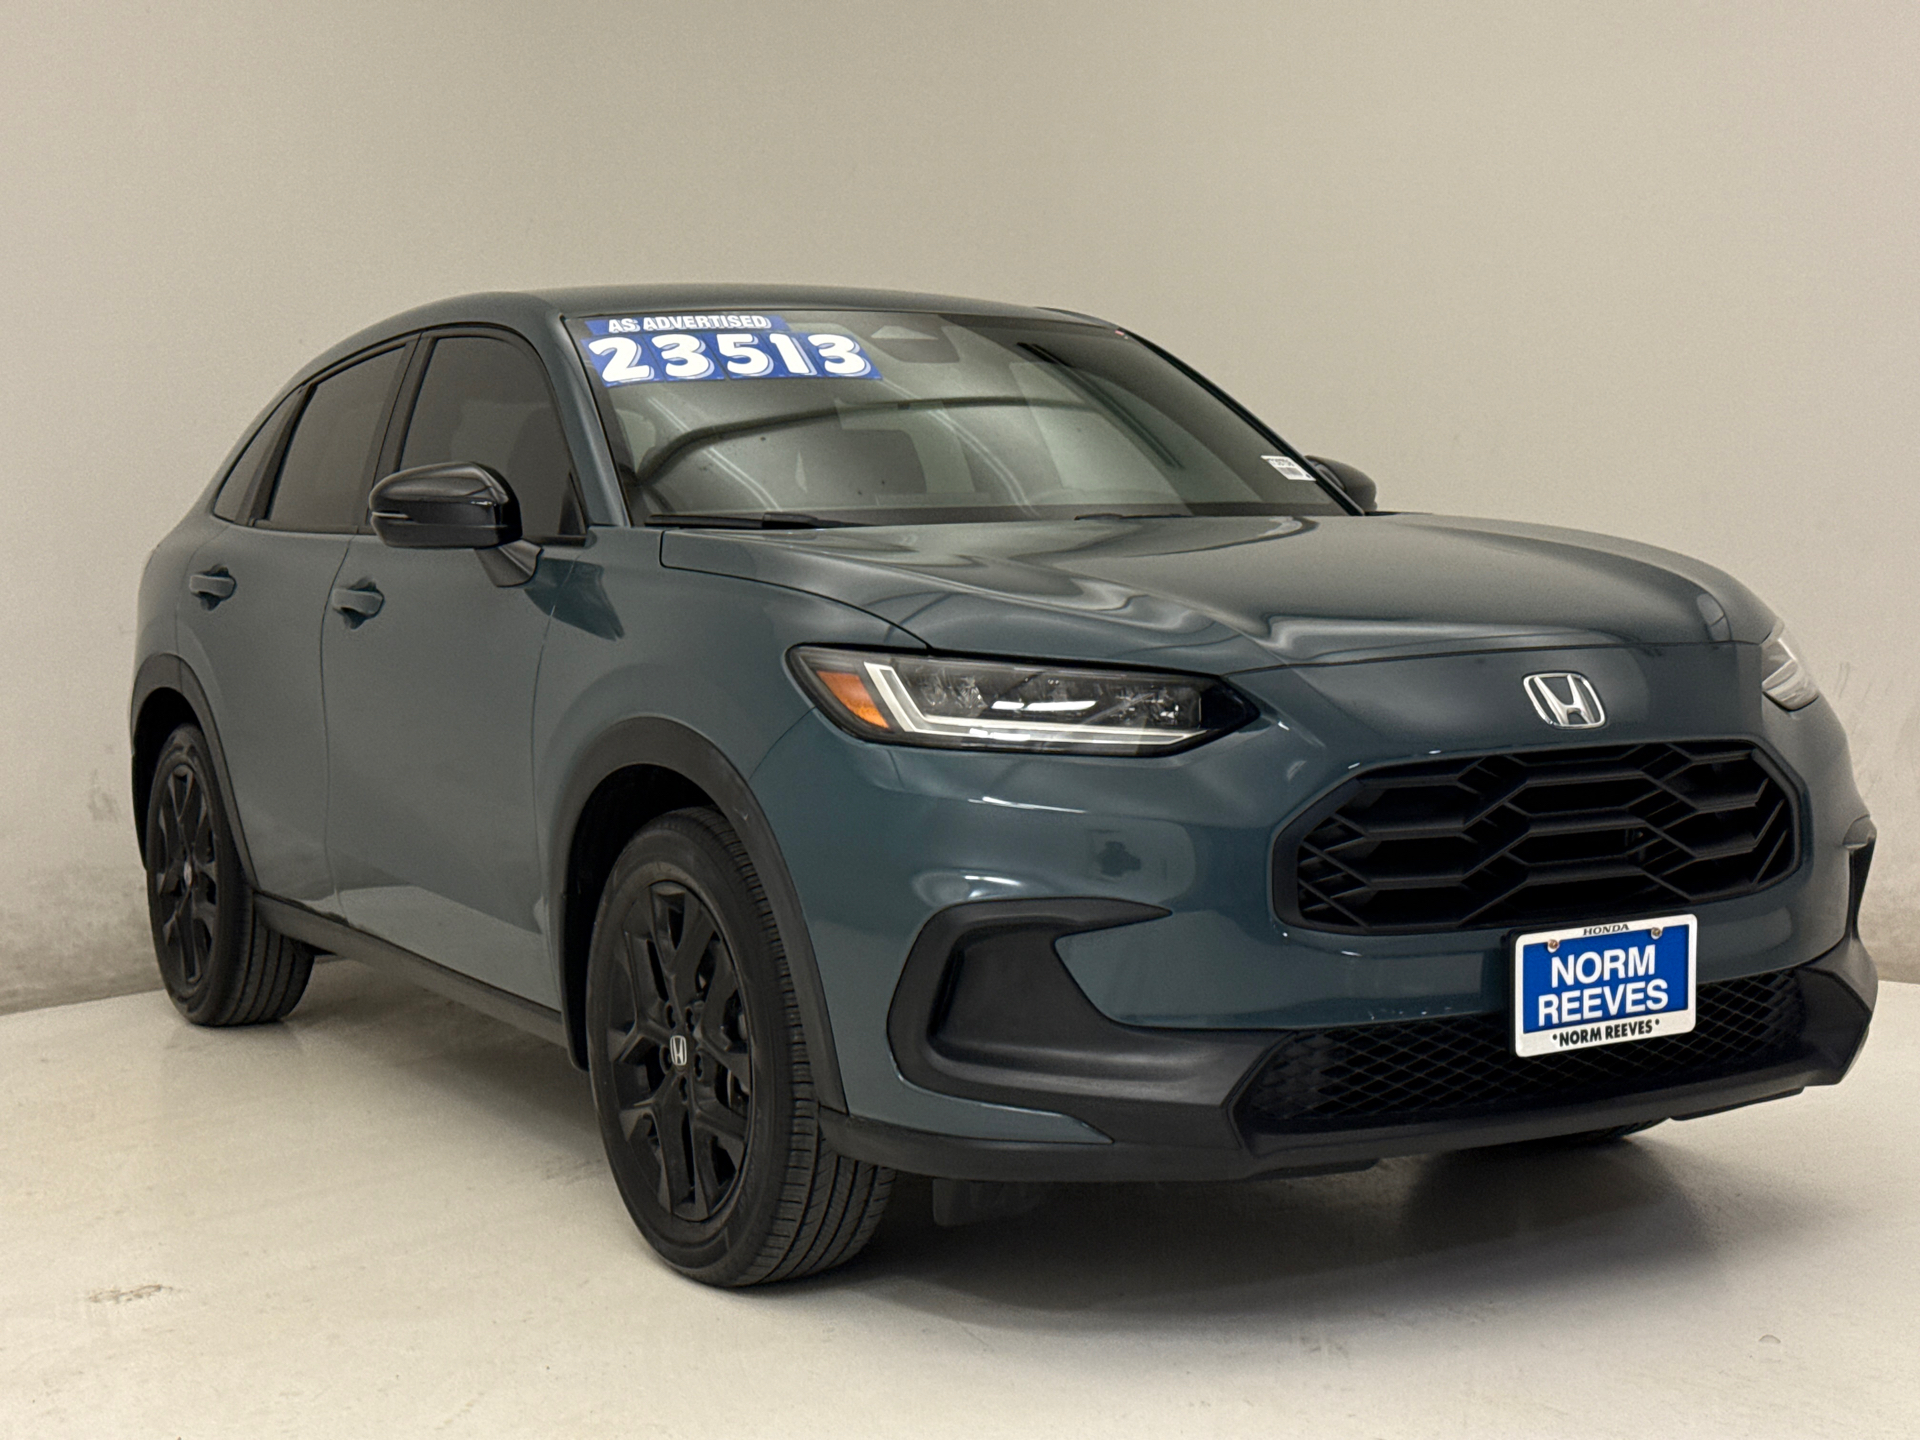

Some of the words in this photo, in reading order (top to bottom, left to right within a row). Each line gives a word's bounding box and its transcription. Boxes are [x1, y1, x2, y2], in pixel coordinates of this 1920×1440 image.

[608, 318, 639, 334] AS
[643, 315, 771, 332] ADVERTISED
[588, 333, 871, 382] 23513
[1583, 924, 1630, 936] HONDA
[1551, 944, 1656, 988] NORM
[1538, 978, 1669, 1027] REEVES
[1559, 1026, 1602, 1047] NORM
[1605, 1019, 1653, 1040] REEVES
